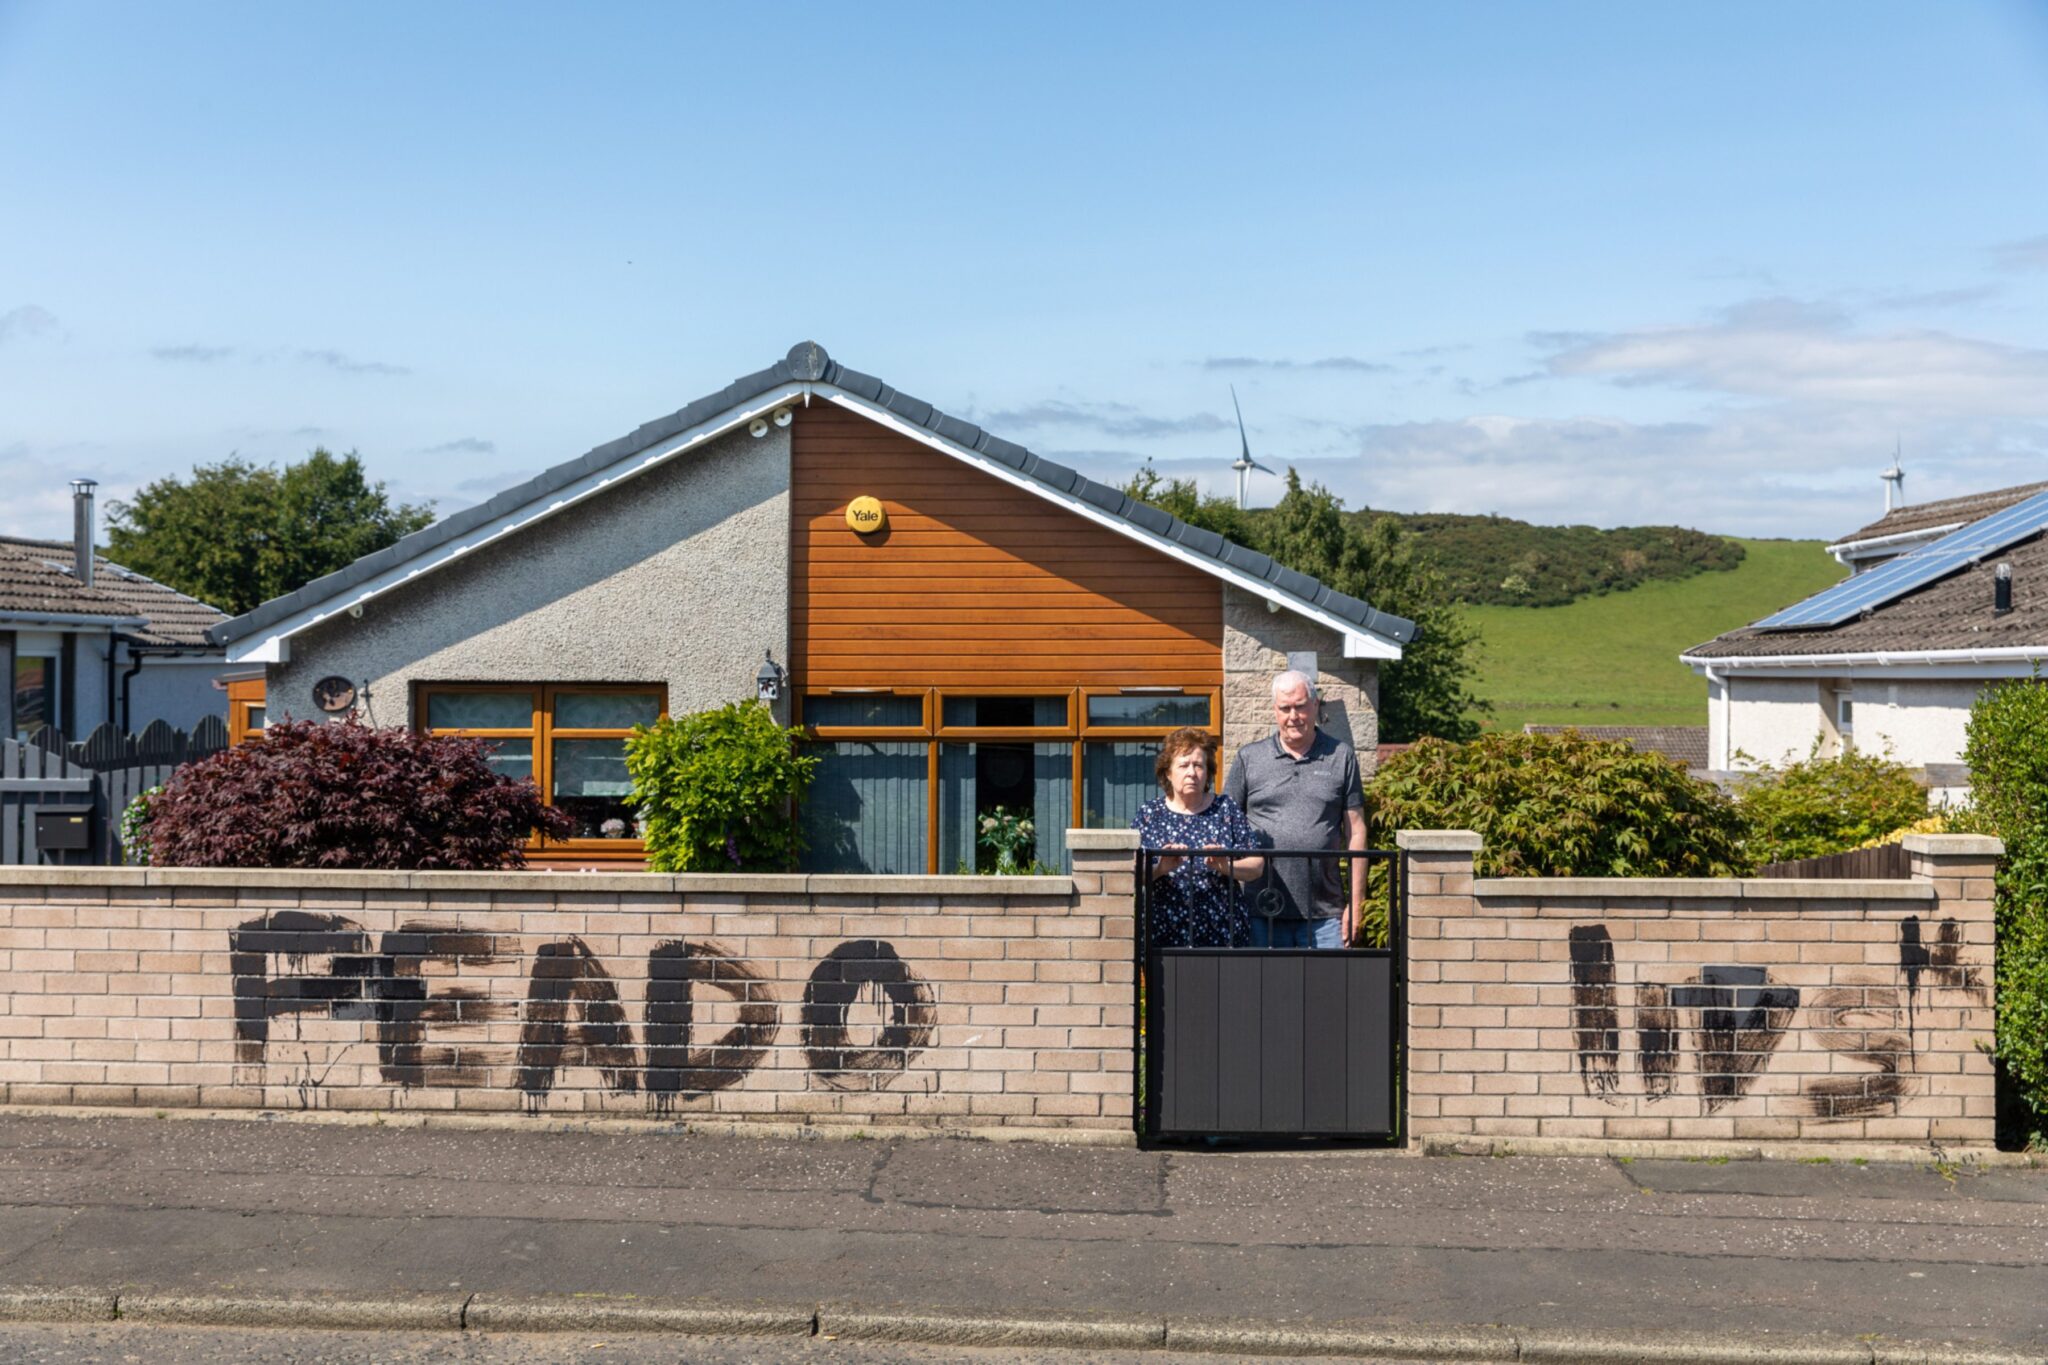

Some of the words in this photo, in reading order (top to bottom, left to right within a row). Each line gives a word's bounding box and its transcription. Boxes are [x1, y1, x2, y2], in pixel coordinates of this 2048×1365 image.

[853, 510, 878, 521] Yale
[1262, 891, 1280, 915] 3
[229, 911, 938, 1104] PEADO
